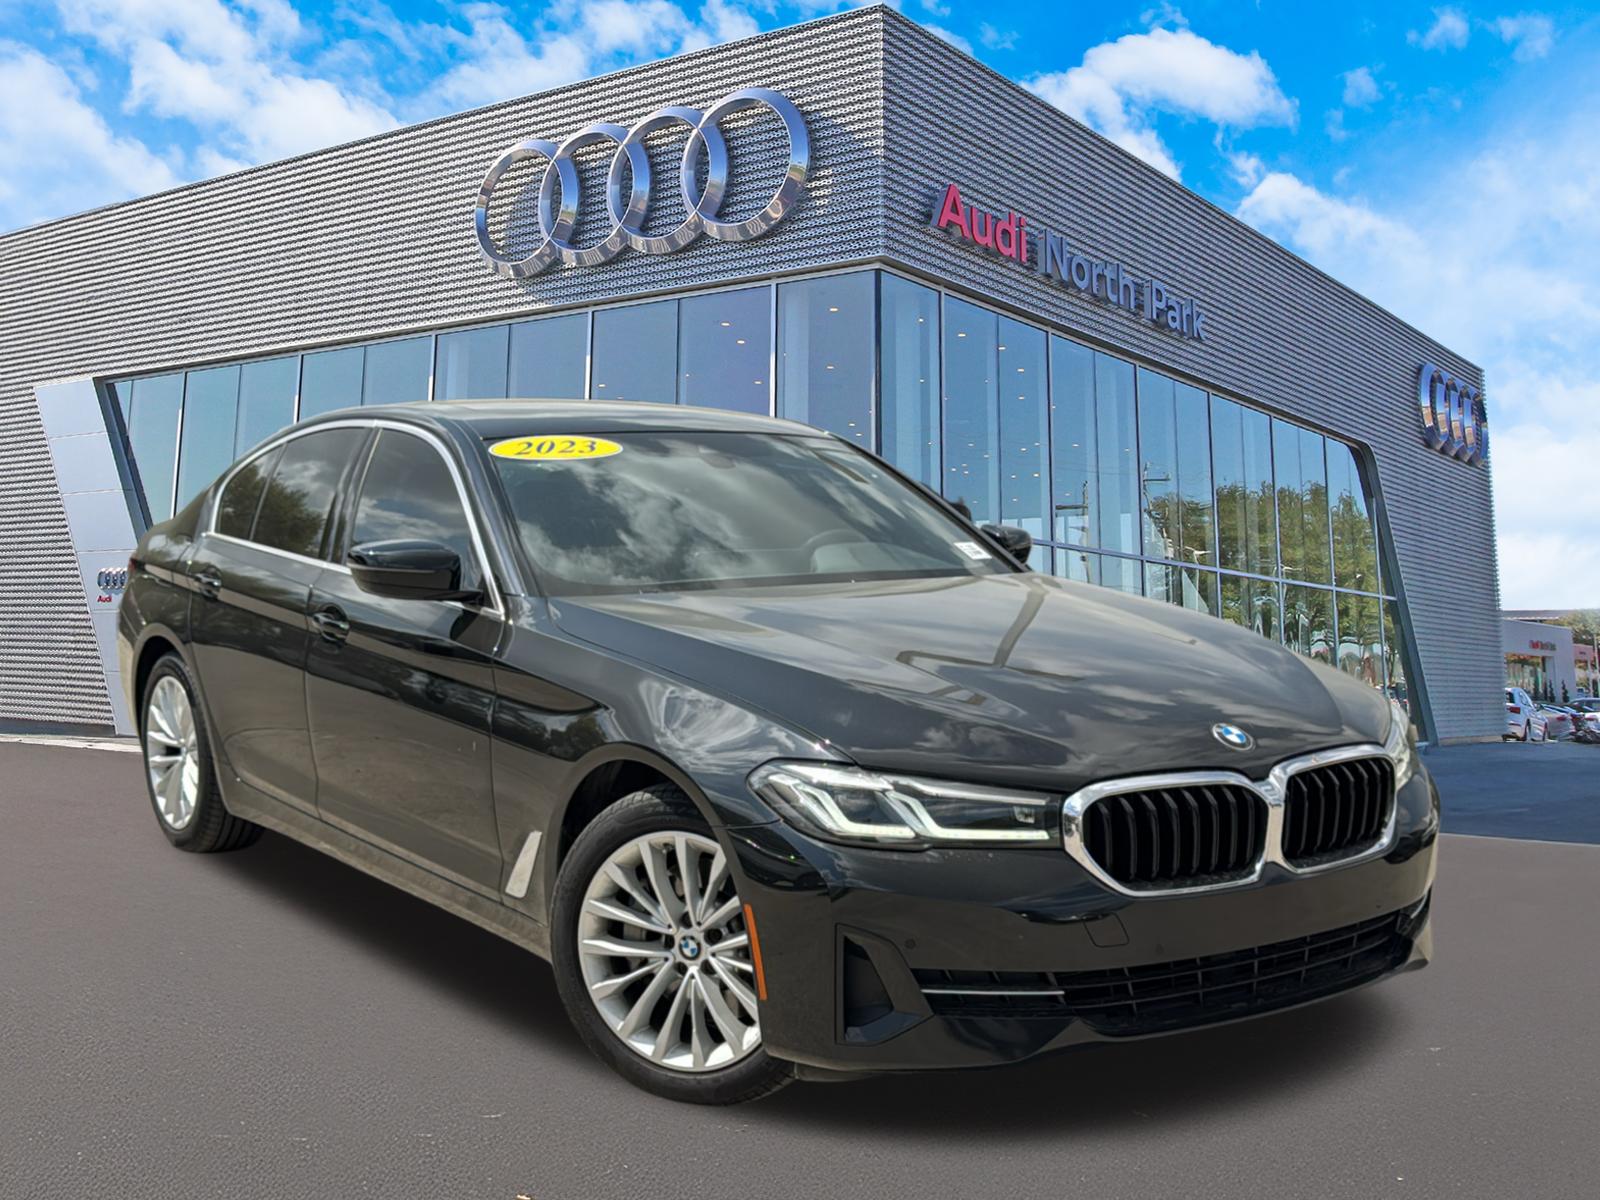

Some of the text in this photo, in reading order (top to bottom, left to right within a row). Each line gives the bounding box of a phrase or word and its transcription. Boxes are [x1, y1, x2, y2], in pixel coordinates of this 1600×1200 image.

[932, 184, 1206, 341] Audi North Park
[515, 440, 597, 455] 2023
